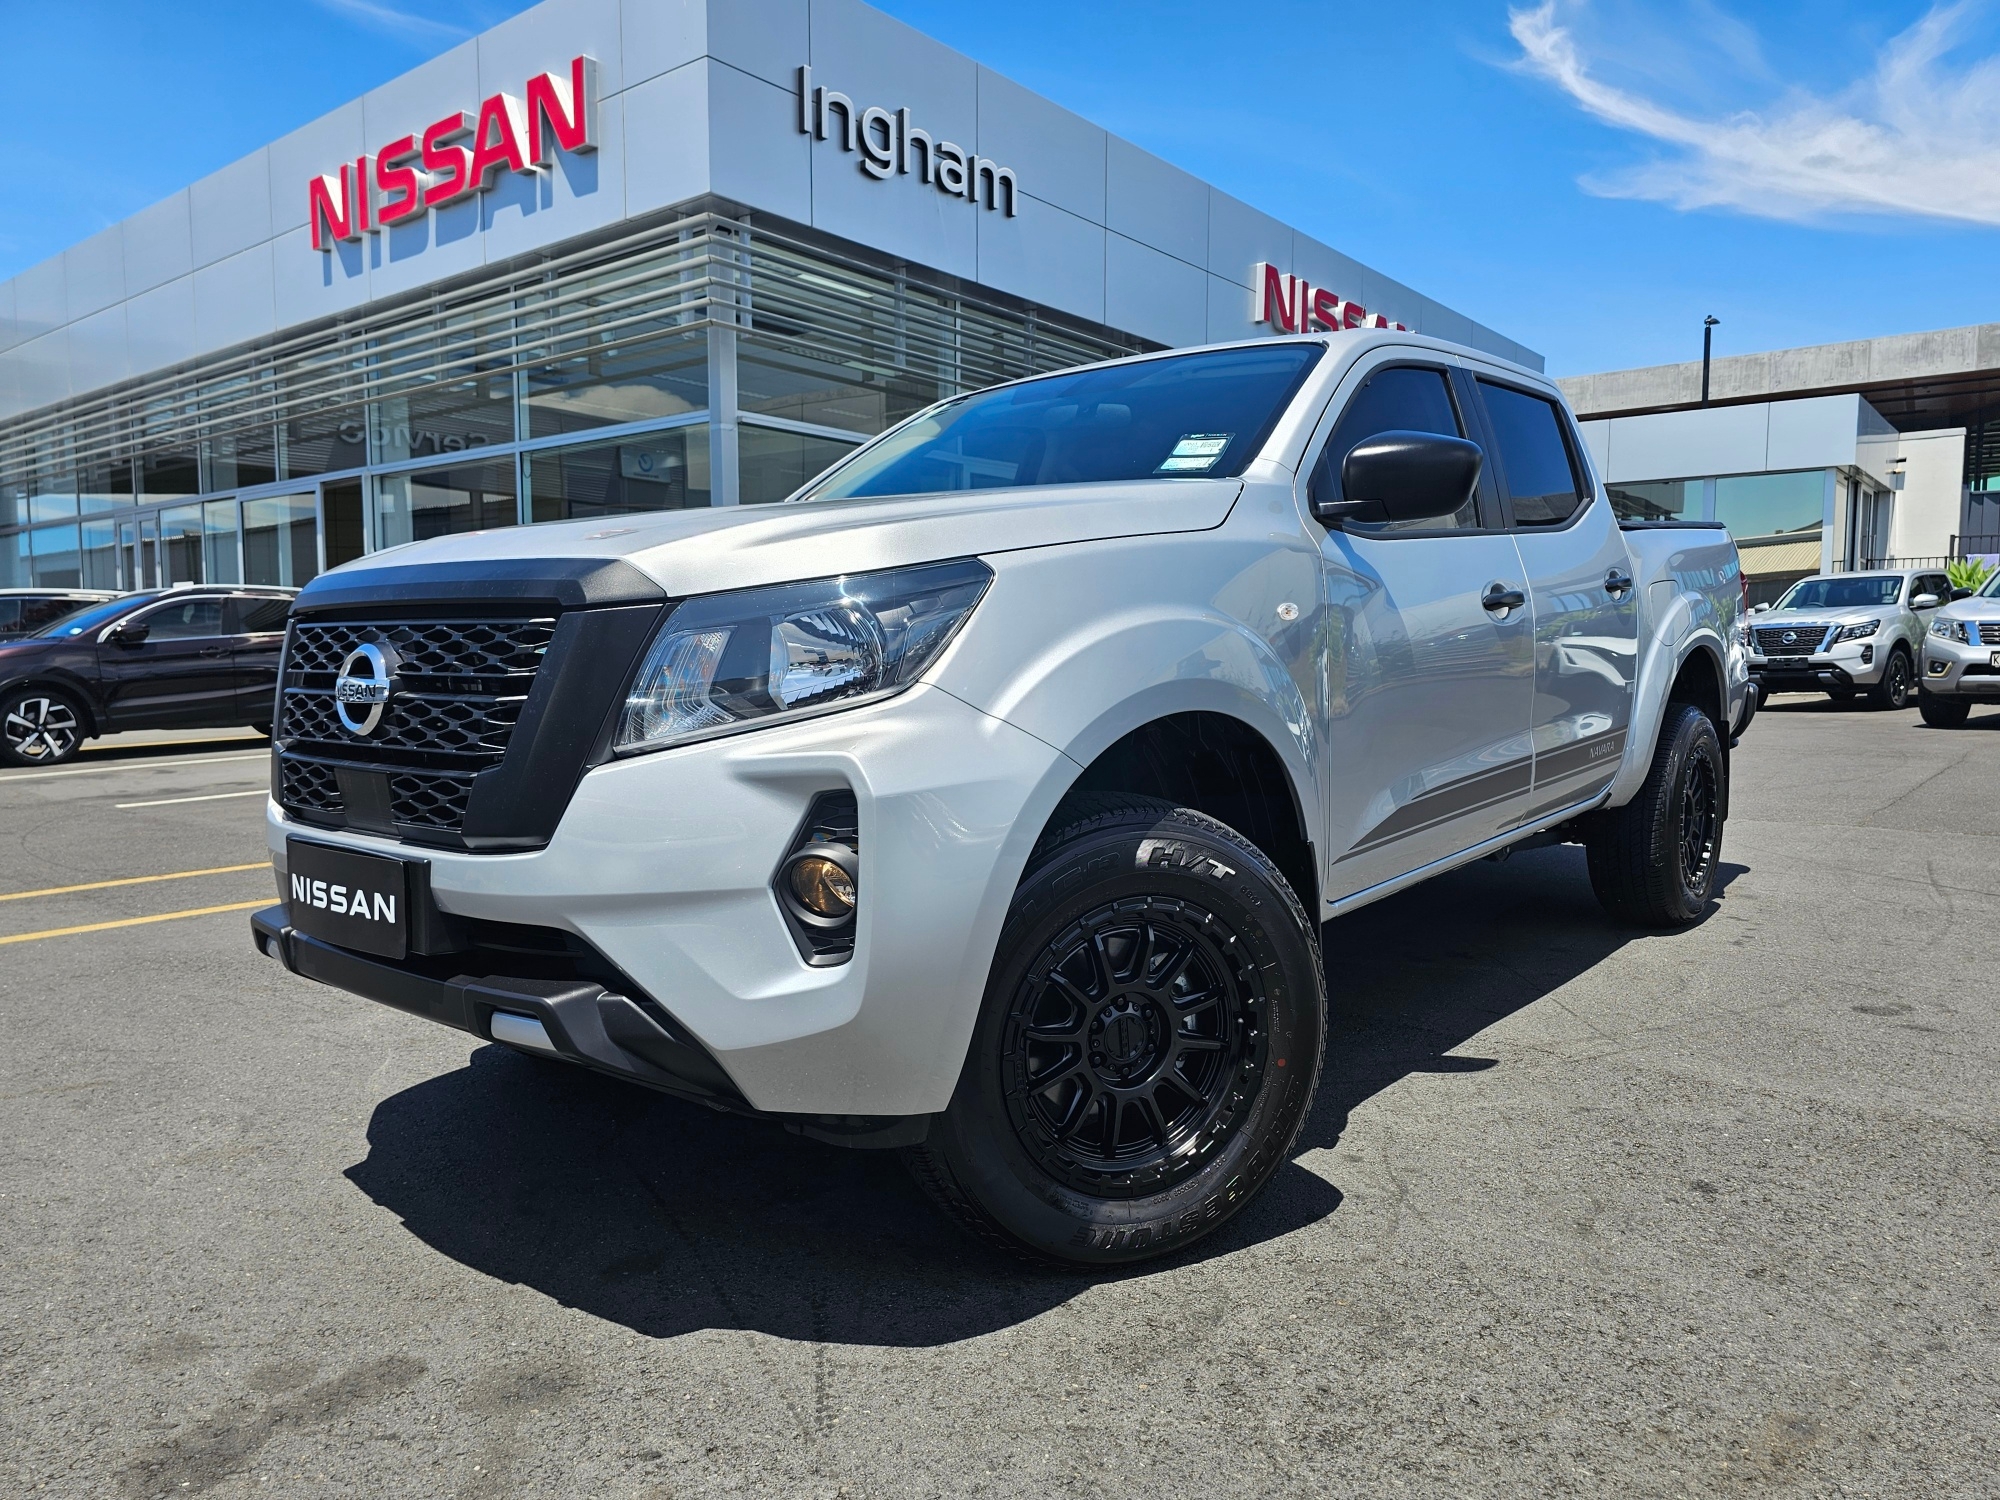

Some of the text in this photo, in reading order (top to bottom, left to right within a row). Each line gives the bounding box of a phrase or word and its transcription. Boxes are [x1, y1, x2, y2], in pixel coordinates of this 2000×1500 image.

[309, 54, 598, 252] NISSAN
[797, 65, 1017, 217] Ingham
[1256, 261, 1406, 334] NISS
[1589, 741, 1615, 758] NAVARA
[1147, 846, 1236, 880] H/T
[291, 873, 396, 924] NISSAN
